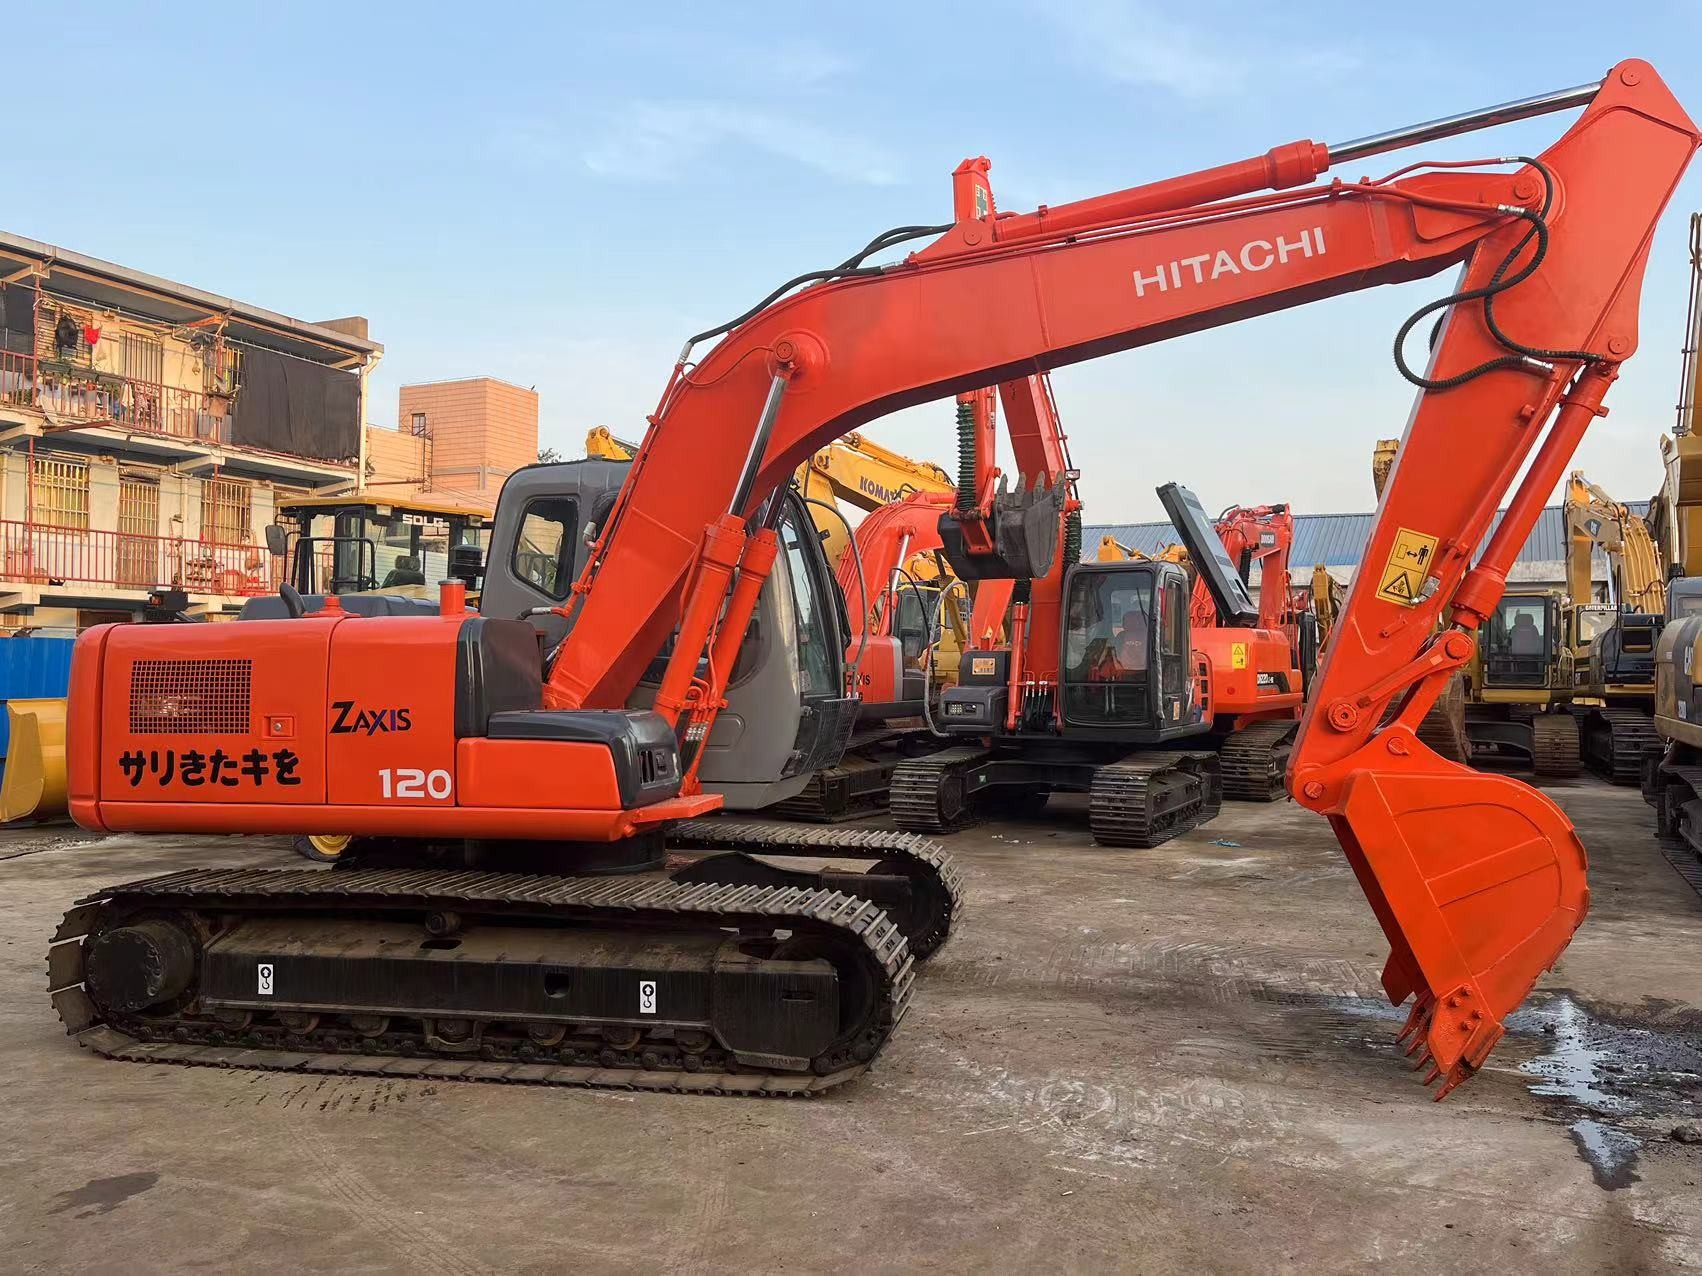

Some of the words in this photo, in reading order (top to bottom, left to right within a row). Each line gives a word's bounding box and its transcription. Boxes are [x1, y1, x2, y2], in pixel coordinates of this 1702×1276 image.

[1132, 226, 1327, 298] HITACHI
[329, 701, 412, 736] ZAXIS
[118, 748, 301, 787] サリきたキを
[378, 768, 452, 800] 120
